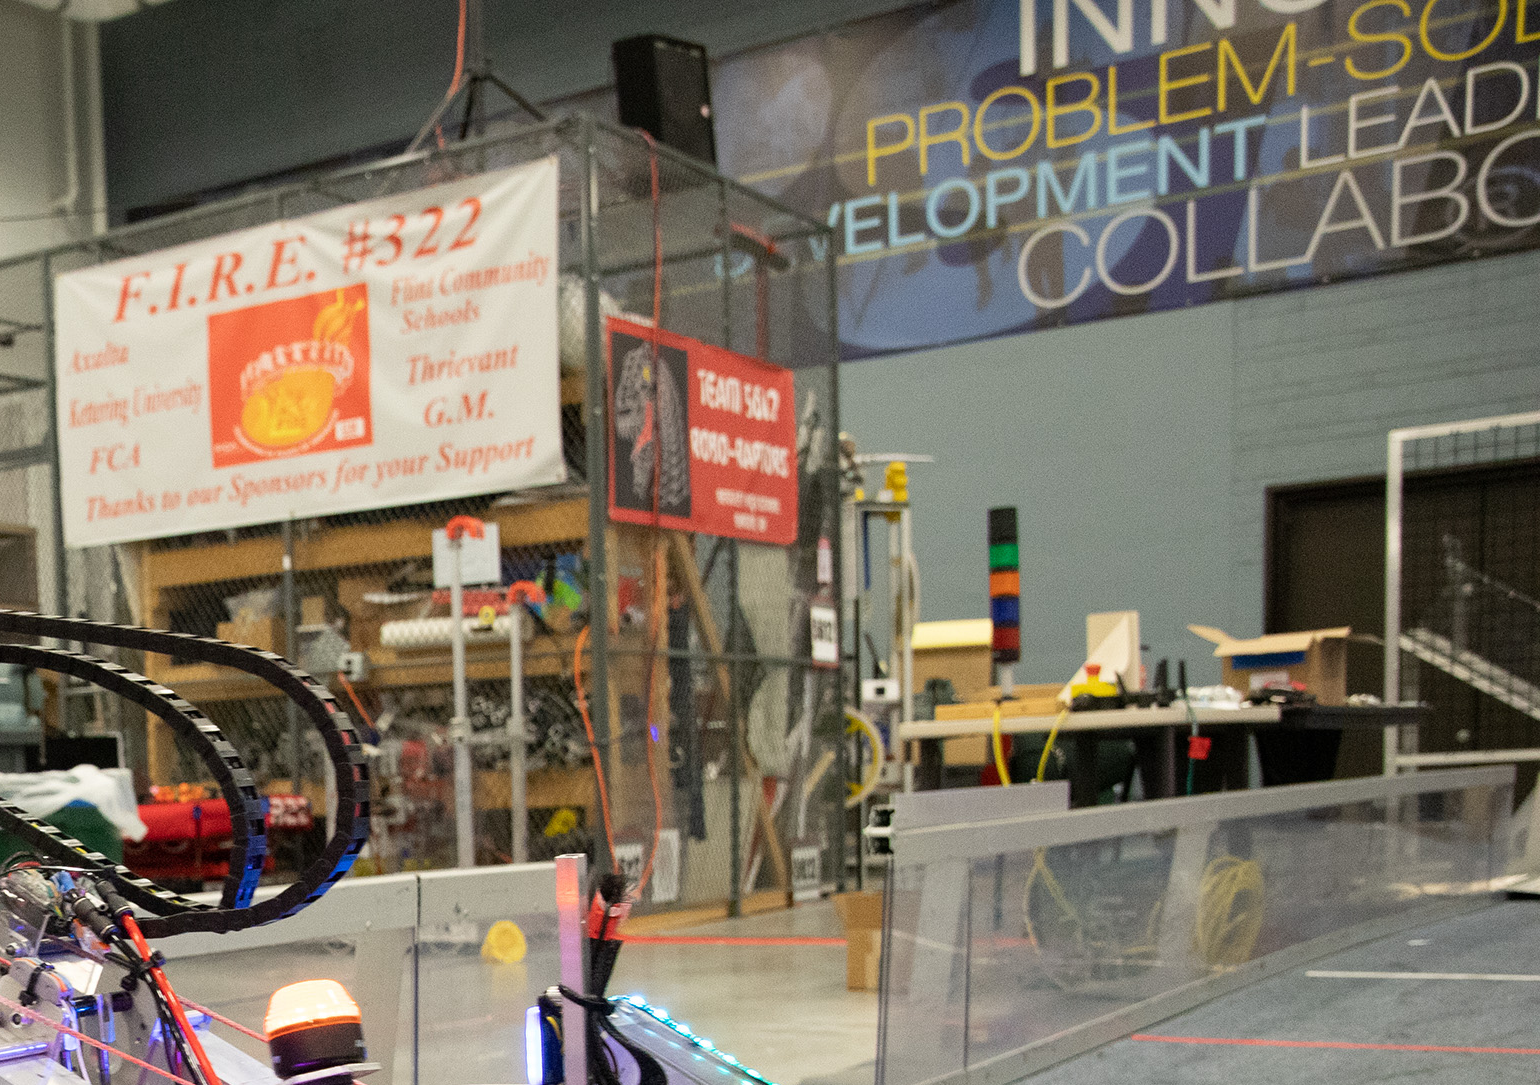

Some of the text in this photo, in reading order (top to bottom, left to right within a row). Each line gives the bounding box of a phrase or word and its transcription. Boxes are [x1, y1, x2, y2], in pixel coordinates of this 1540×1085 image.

[1300, 61, 1532, 168] LEAD
[113, 196, 484, 324] F.I.R.E. #322
[400, 299, 481, 335] Schools
[423, 388, 496, 428] G.M.
[697, 368, 742, 415] TEAM
[87, 436, 536, 523] Thanks to our Sponsors for your Support
[89, 441, 141, 475] FCA
